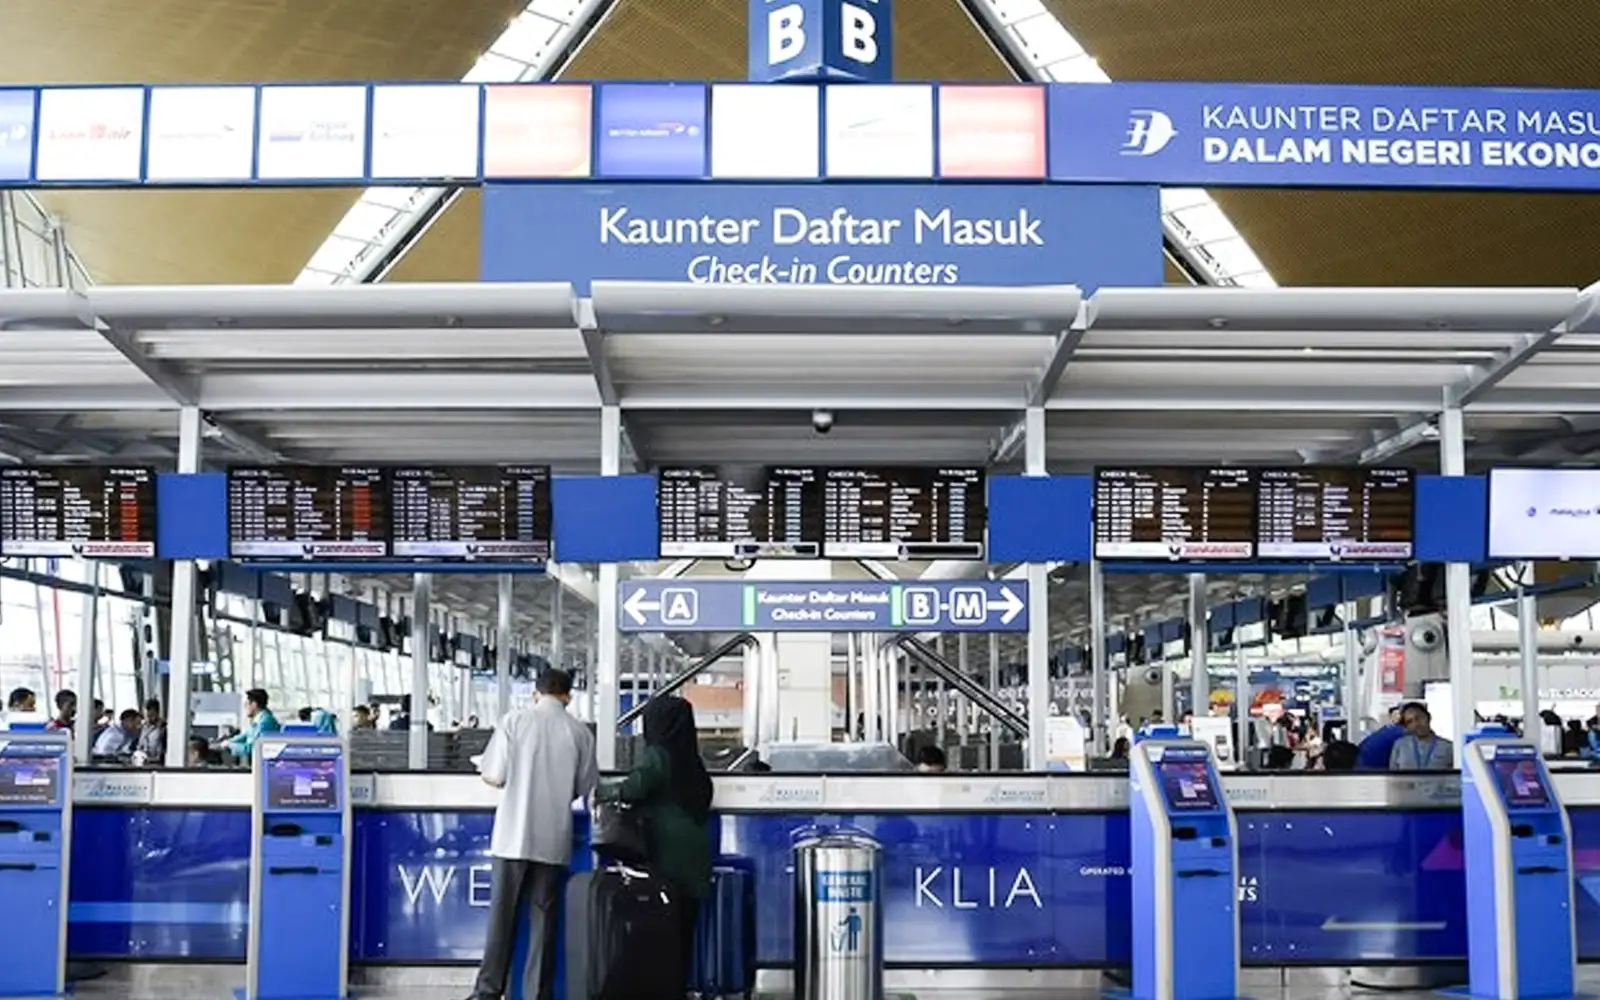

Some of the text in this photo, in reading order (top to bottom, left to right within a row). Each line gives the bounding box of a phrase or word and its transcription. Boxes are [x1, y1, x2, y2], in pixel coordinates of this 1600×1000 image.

[768, 4, 806, 66] B
[842, 3, 878, 64] B
[1203, 105, 1360, 131] KAUNTER
[1373, 107, 1506, 134] DAFTAR
[1203, 138, 1331, 163] DALAM
[1342, 139, 1471, 166] NEGERI
[600, 207, 1043, 246] Kaunter Daftar Masuk
[688, 255, 959, 284] Check-in Counters
[667, 592, 691, 619] A
[915, 867, 1043, 908] KLIA
